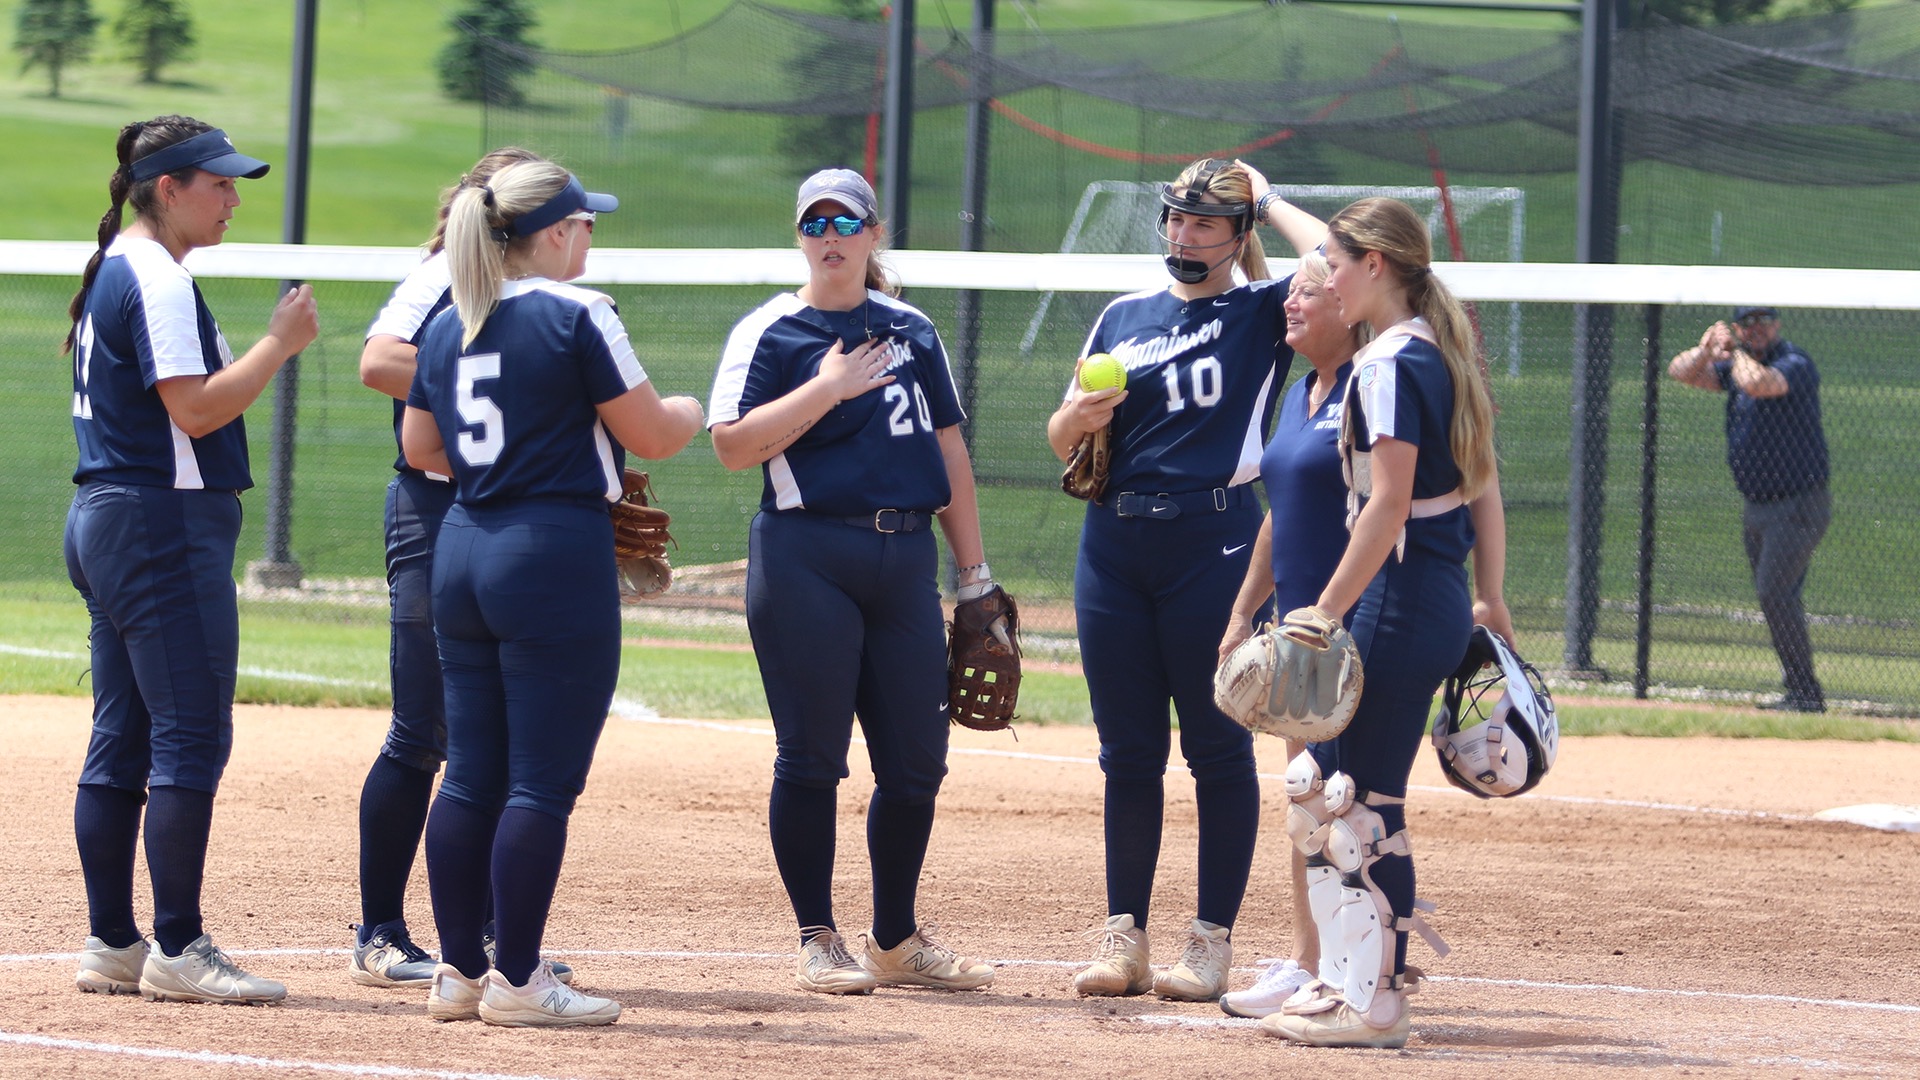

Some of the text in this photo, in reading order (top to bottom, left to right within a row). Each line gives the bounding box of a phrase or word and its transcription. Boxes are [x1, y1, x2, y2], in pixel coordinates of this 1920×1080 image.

[456, 351, 505, 467] 5
[884, 381, 933, 436] 20
[1161, 355, 1223, 413] 10
